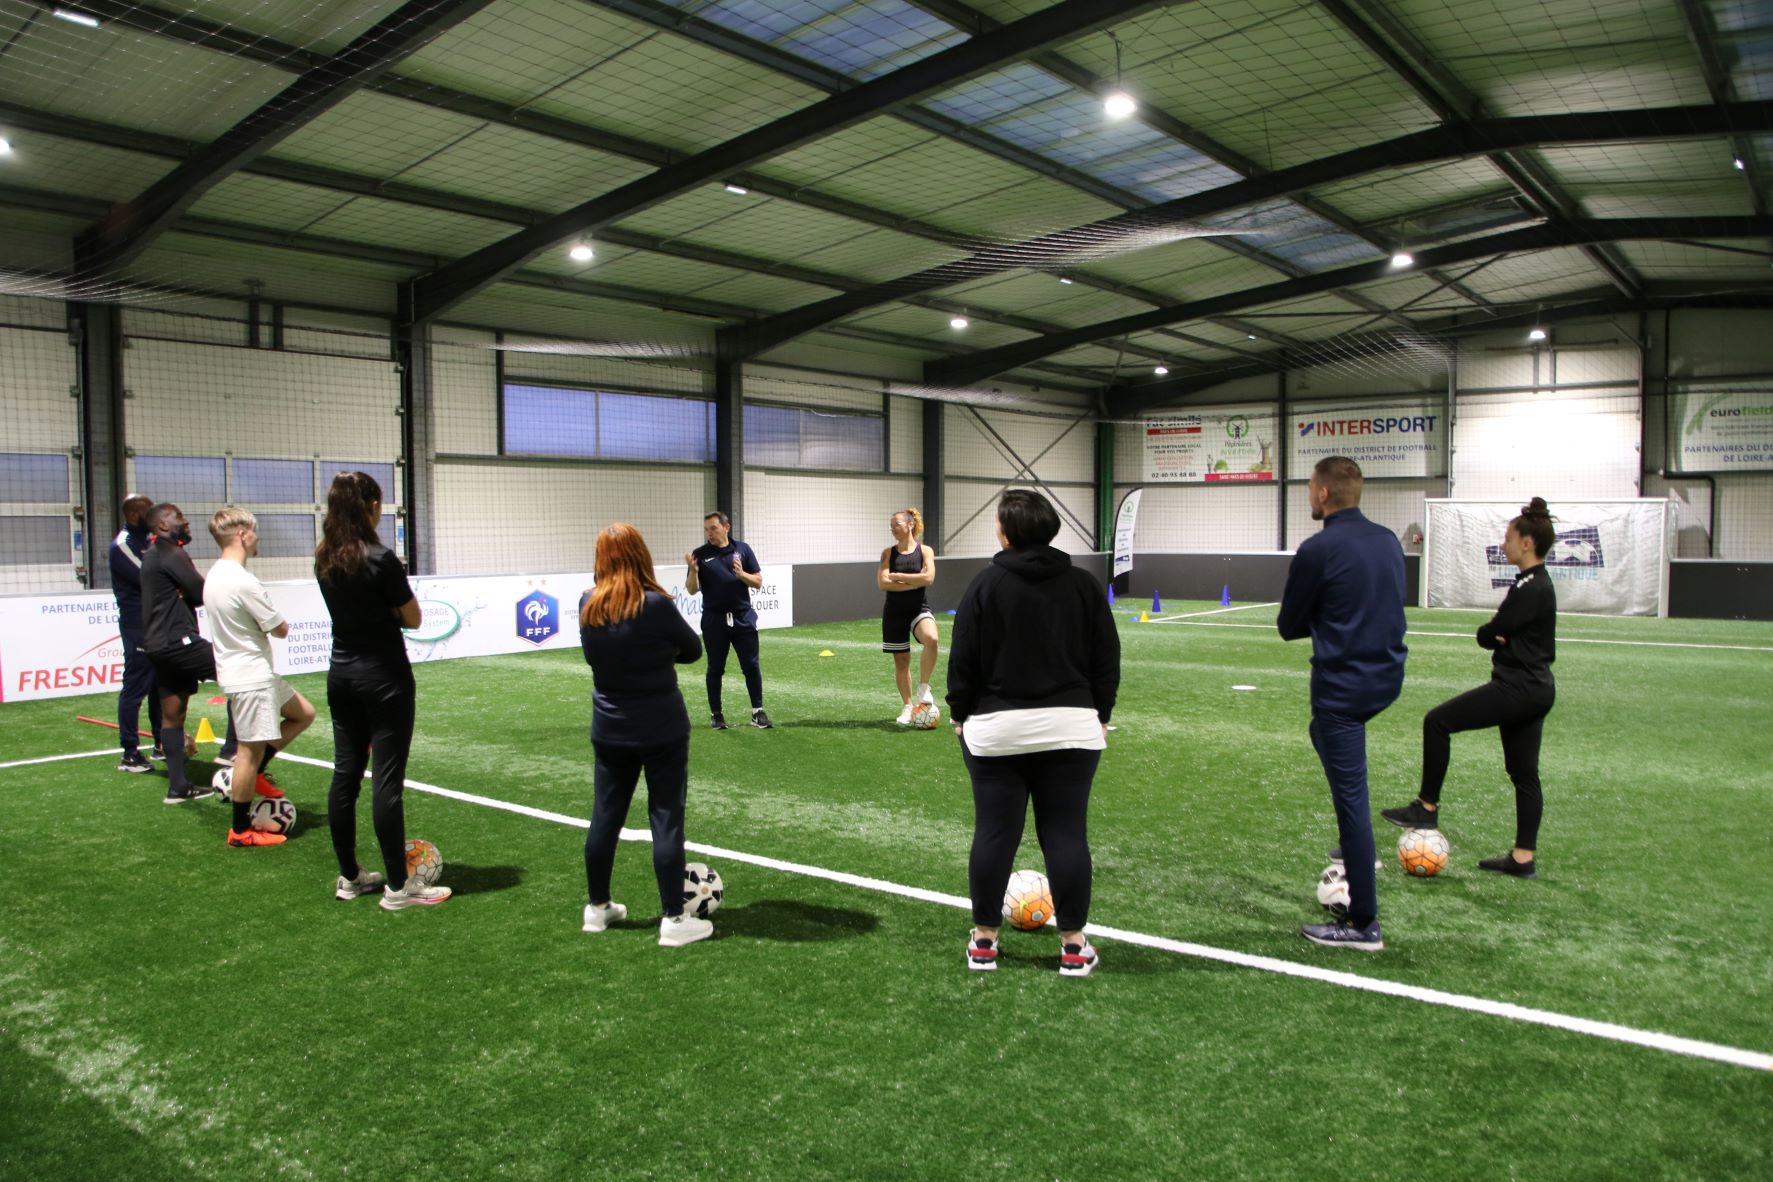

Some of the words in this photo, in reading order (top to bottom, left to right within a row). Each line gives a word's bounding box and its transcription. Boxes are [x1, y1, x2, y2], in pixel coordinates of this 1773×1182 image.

[1316, 416, 1437, 436] INTERSPORT
[751, 585, 777, 596] SPACE
[42, 602, 109, 614] PARTENAIRE
[424, 608, 449, 617] OSAGE
[88, 615, 102, 624] DE
[288, 634, 300, 642] DU
[303, 632, 331, 642] DISTRI
[526, 627, 551, 637] FFF
[97, 647, 124, 658] Grou
[18, 663, 125, 692] FRESNE
